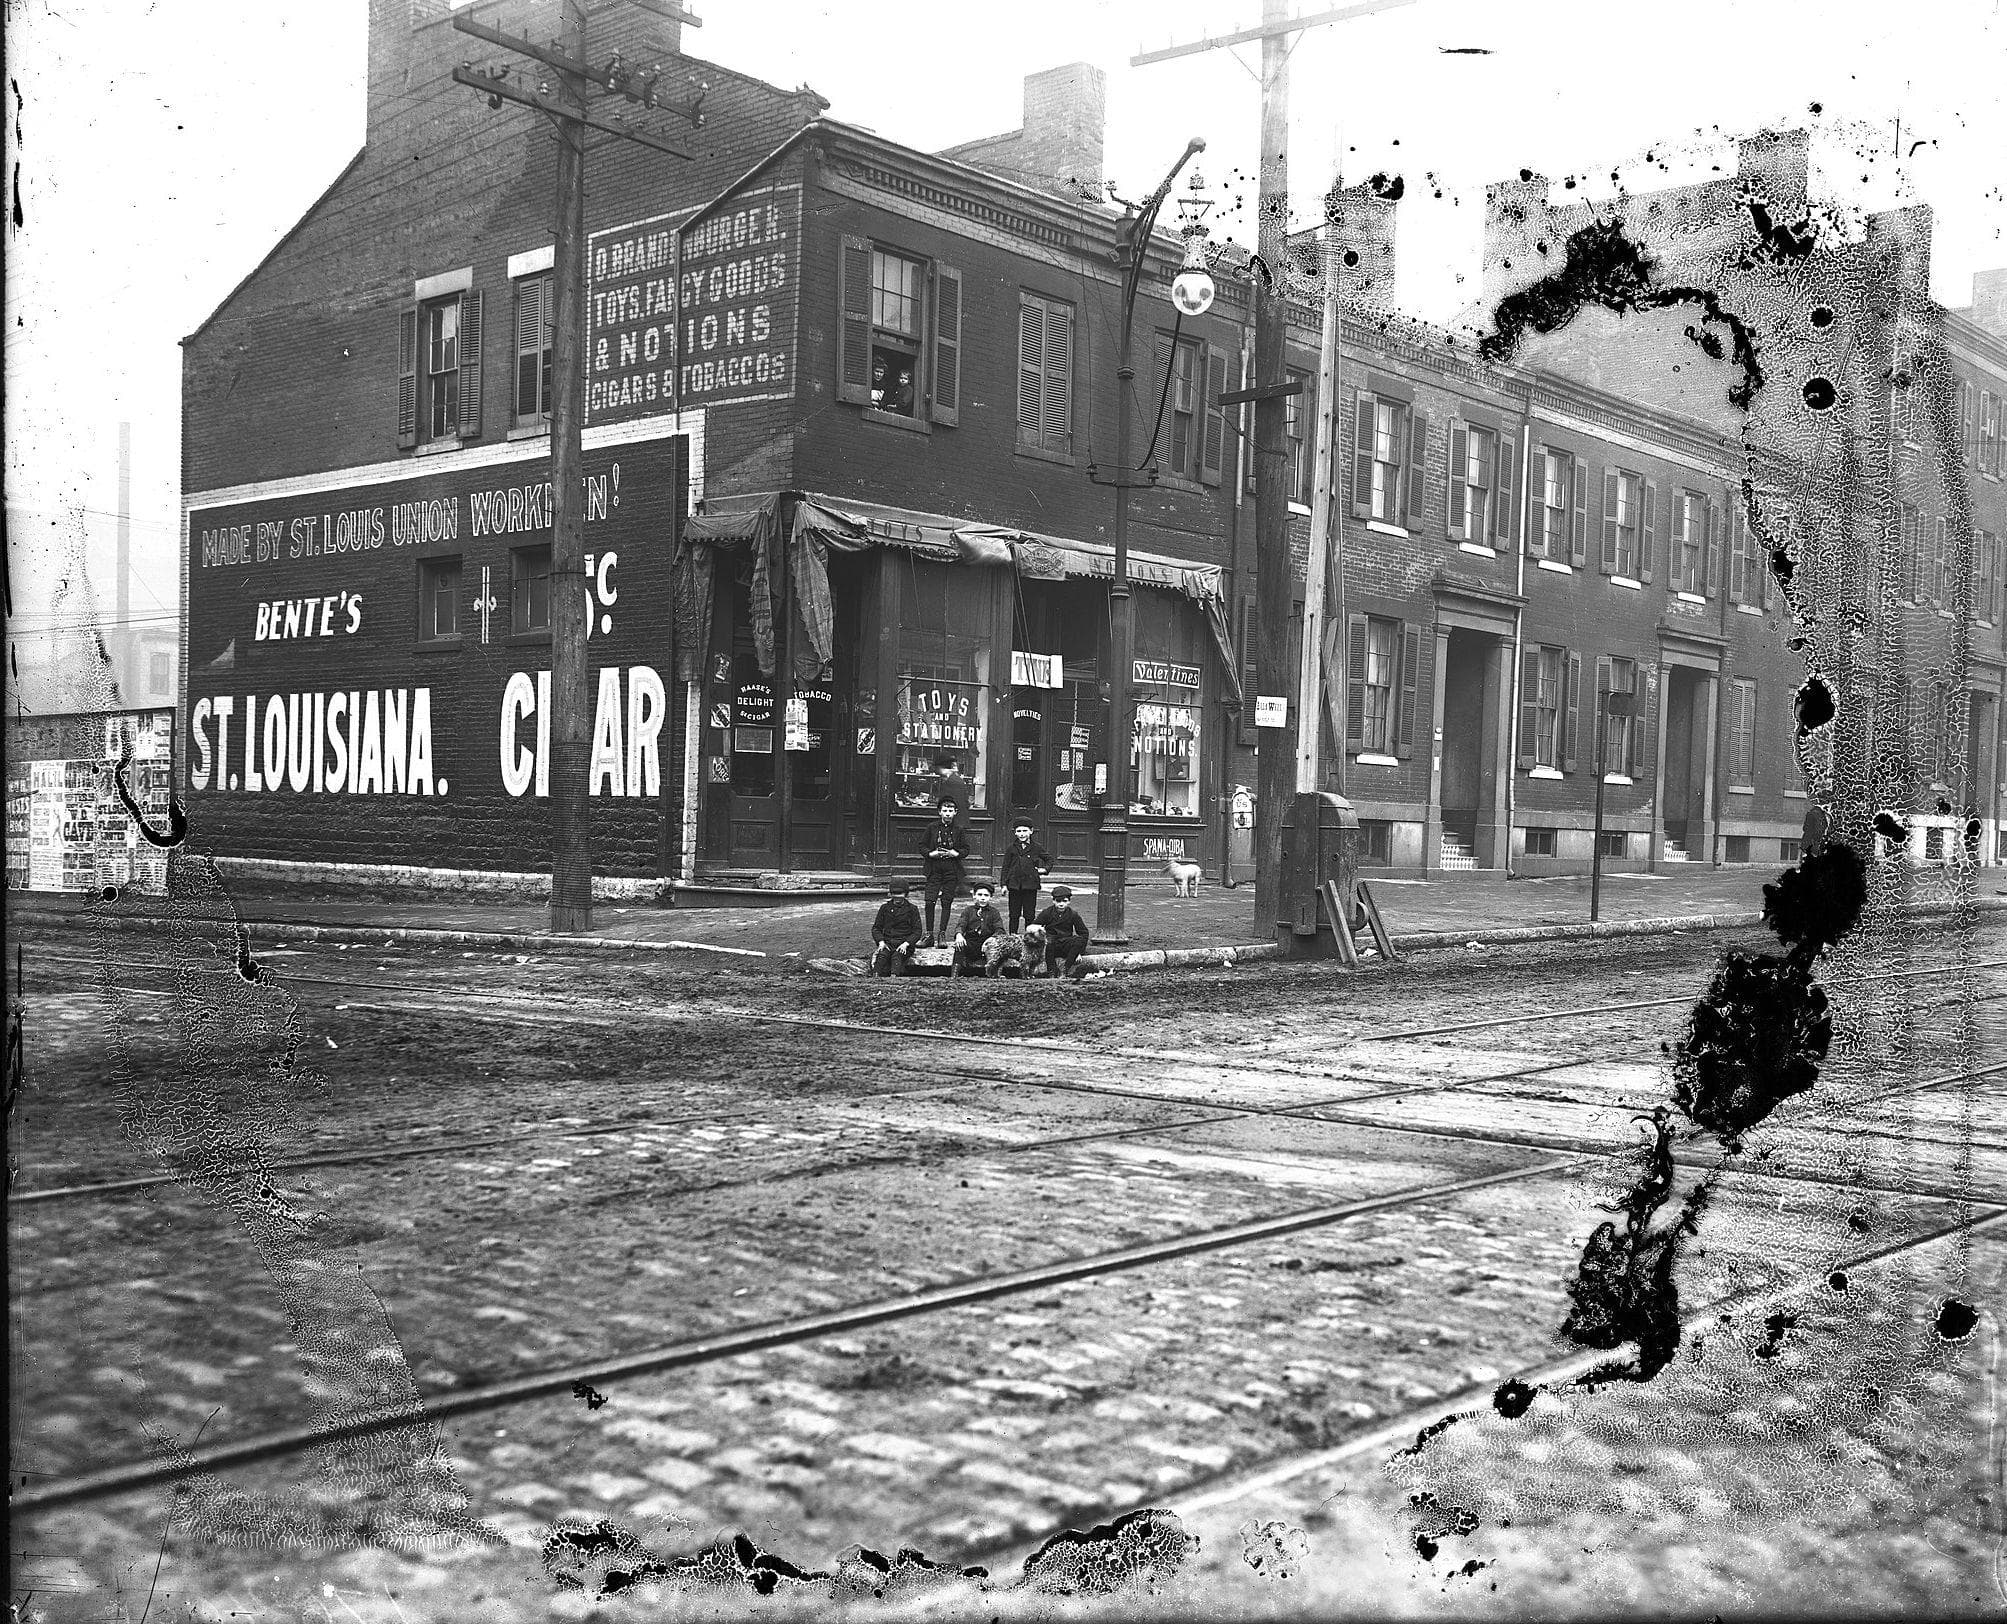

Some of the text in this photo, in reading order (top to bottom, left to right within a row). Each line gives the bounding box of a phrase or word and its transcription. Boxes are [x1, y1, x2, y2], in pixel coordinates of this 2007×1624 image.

[709, 253, 786, 303] GOODS
[595, 304, 770, 371] & NOTIONS
[591, 372, 657, 411] CIGARS
[681, 352, 786, 395] TOBACCOS
[202, 462, 620, 568] MADE BY ST. LOUIS UNION WORKN!
[1089, 555, 1174, 584] NOIONS
[254, 590, 363, 642] BENTE'S
[1135, 663, 1199, 685] Valentines
[737, 696, 775, 708] DELIGHT
[794, 690, 832, 702] TOBACCO
[918, 689, 970, 717] TOYS
[746, 711, 771, 721] CIGAR
[934, 712, 950, 721] AND
[1013, 709, 1042, 721] NOVELTIES
[244, 687, 449, 796] LOUISIANA.
[500, 665, 667, 798] CIAR
[902, 722, 983, 742] STATIONERY
